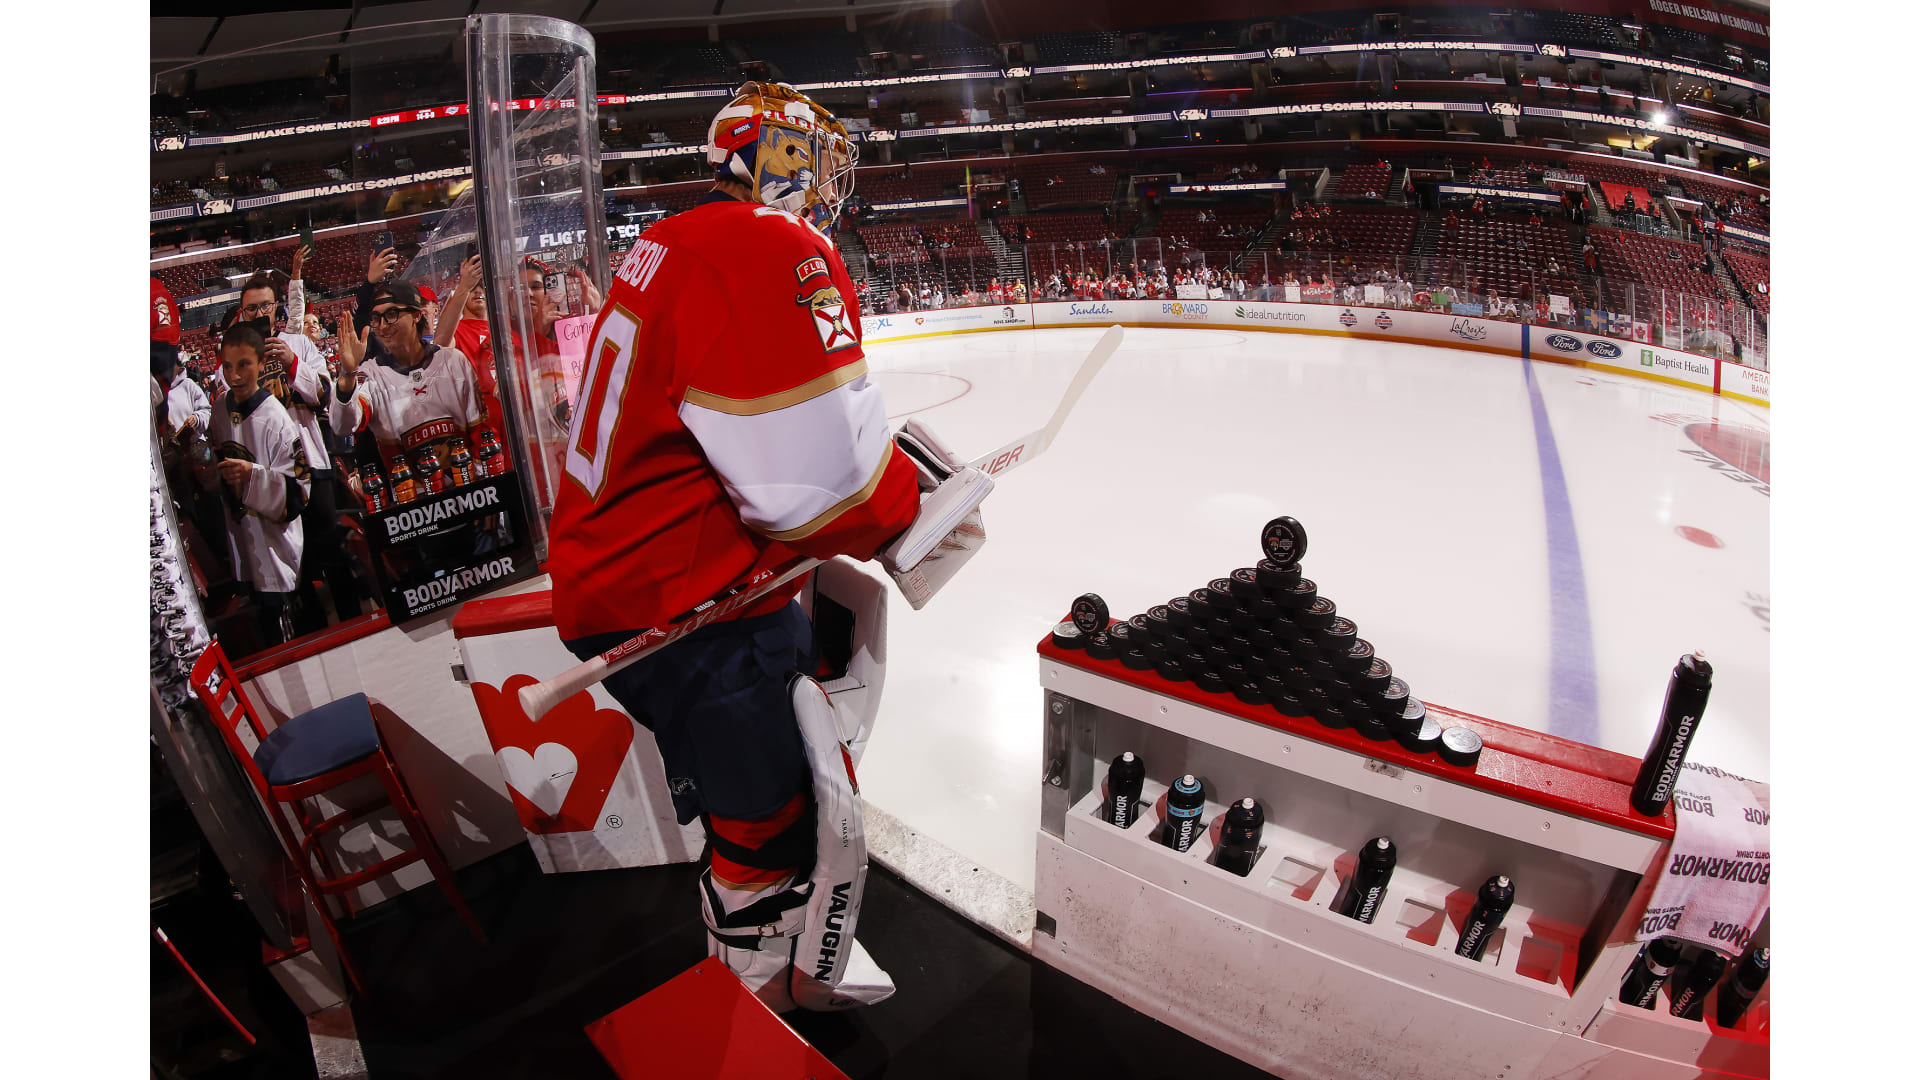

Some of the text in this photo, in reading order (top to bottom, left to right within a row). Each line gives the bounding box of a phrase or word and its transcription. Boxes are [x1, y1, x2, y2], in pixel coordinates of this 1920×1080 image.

[1650, 0, 1681, 15] ROGER
[1681, 5, 1720, 23] NEILSON
[1720, 13, 1765, 36] MEMORIAL
[1358, 41, 1475, 50] MAKE SOME NOISE
[1093, 55, 1207, 71] MAKE SOME NOISE
[1625, 55, 1731, 83] MAKE SOME NOISE
[823, 74, 941, 88] MAKE SOME NOISE
[626, 92, 668, 103] NOISE
[1278, 101, 1413, 114] MAKE SOME NOISE
[252, 119, 370, 140] MAKE SOME NOIS
[969, 117, 1104, 133] MAKE SOME NOISE
[1591, 113, 1720, 144] MAKE SOME NOISE
[652, 145, 698, 157] MAKE
[315, 167, 464, 196] MAKE SOME NOISE
[540, 230, 587, 248] FLIGT
[1069, 303, 1113, 315] Sandals
[1162, 302, 1208, 315] BROWARD
[1246, 308, 1306, 321] idealnutrition
[877, 318, 893, 330] XL
[1451, 318, 1487, 336] LaCroix
[1553, 336, 1616, 357] Ford Ford
[1655, 355, 1709, 375] Baptist Health
[1742, 370, 1770, 384] AMERA
[1751, 384, 1769, 396] BANK
[407, 423, 455, 446] FLORIDA
[979, 444, 1025, 476] UER
[384, 486, 500, 536] BODYARMOR
[390, 524, 439, 544] SPORTS DRINK
[403, 557, 515, 608] BODYARMOR
[410, 595, 457, 616] SPORTS DRINK
[1652, 715, 1695, 803] BODYARMOR
[1669, 853, 1770, 885] BODYARMOR
[814, 881, 852, 982] VAUGHN
